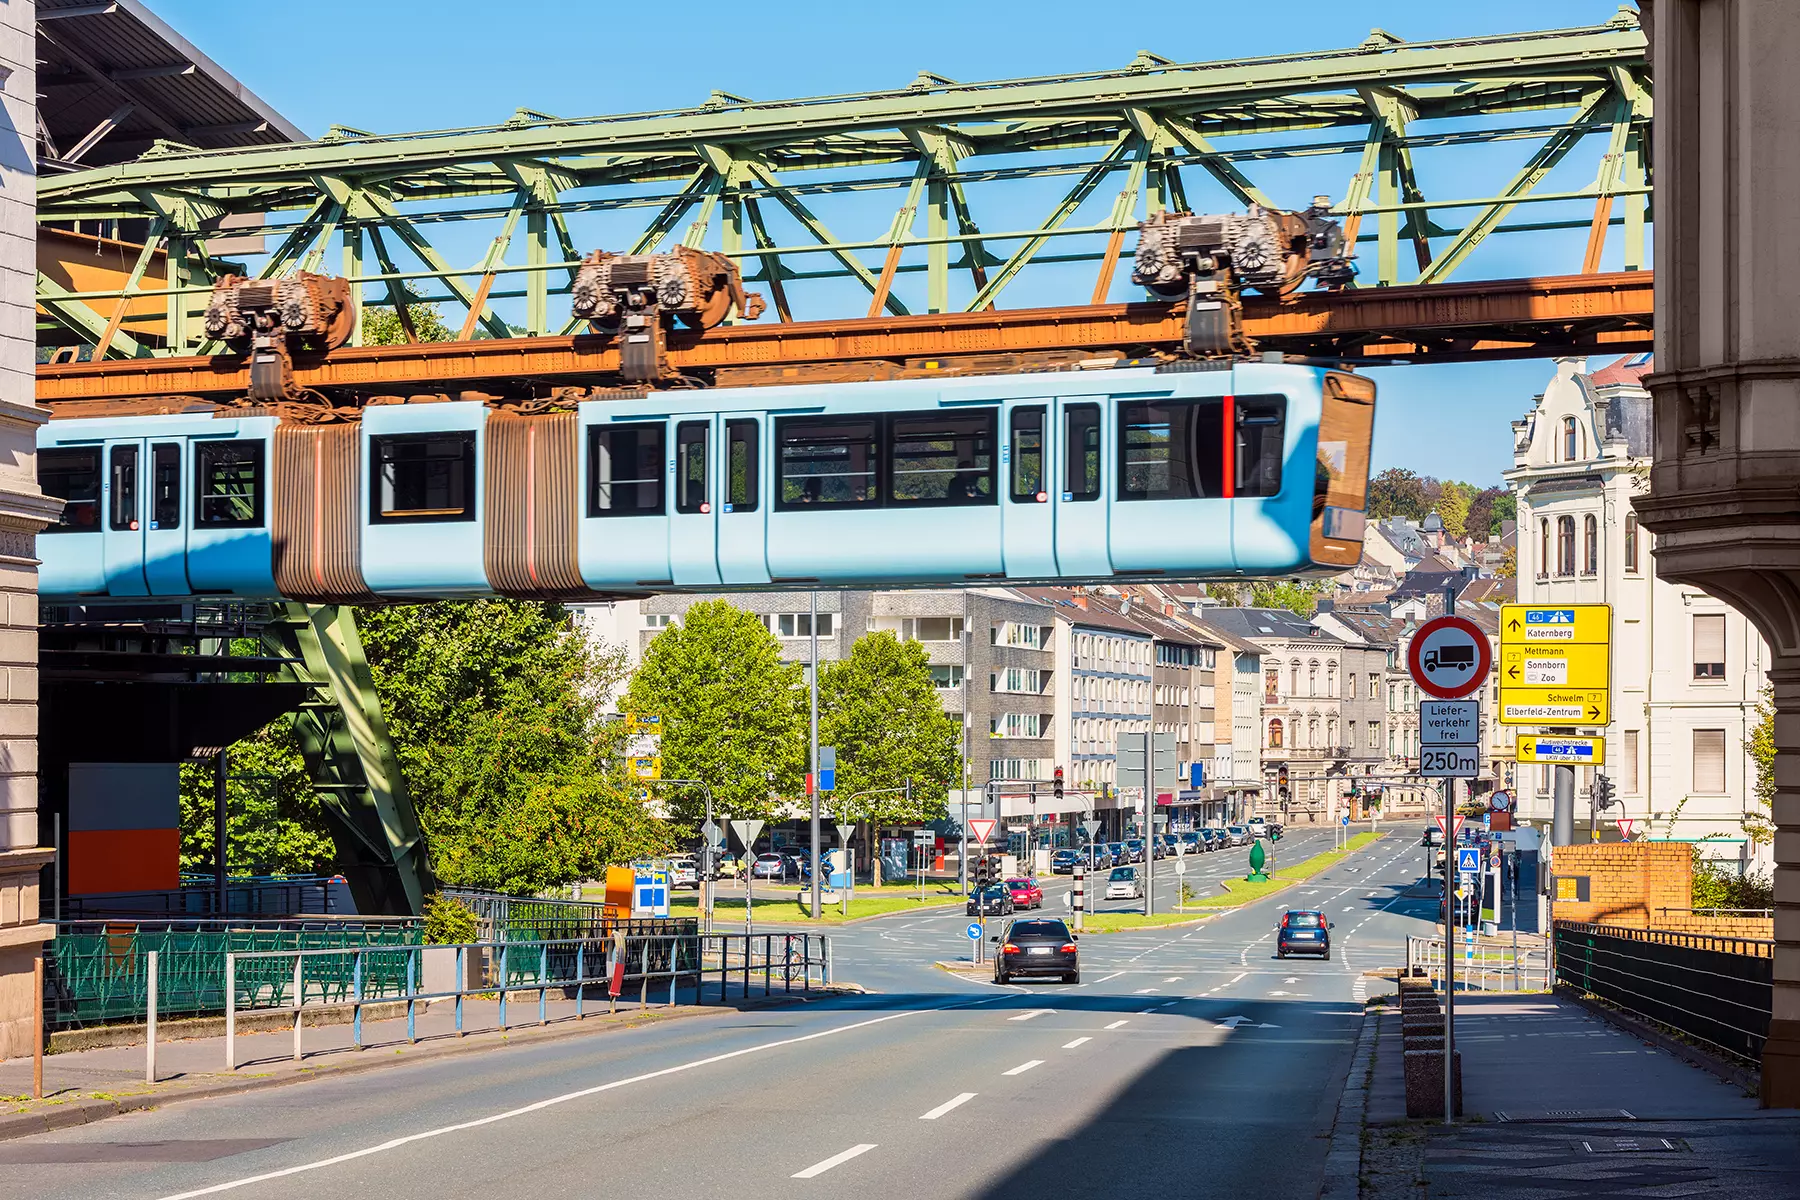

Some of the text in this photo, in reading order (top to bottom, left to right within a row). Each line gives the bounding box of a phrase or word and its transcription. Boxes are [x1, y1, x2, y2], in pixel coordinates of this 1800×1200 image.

[1527, 629, 1572, 639] Katernberg
[1524, 647, 1564, 655] Mettmann
[1527, 660, 1566, 669] Sonnborn
[1541, 673, 1556, 682] Zoo
[1547, 693, 1584, 702] Schwelm
[1431, 705, 1468, 716] Liefer-
[1506, 707, 1581, 716] Elberfeld-Zentrum
[1428, 717, 1470, 728] verkehr
[1440, 730, 1459, 740] frei
[1423, 751, 1476, 771] 250m
